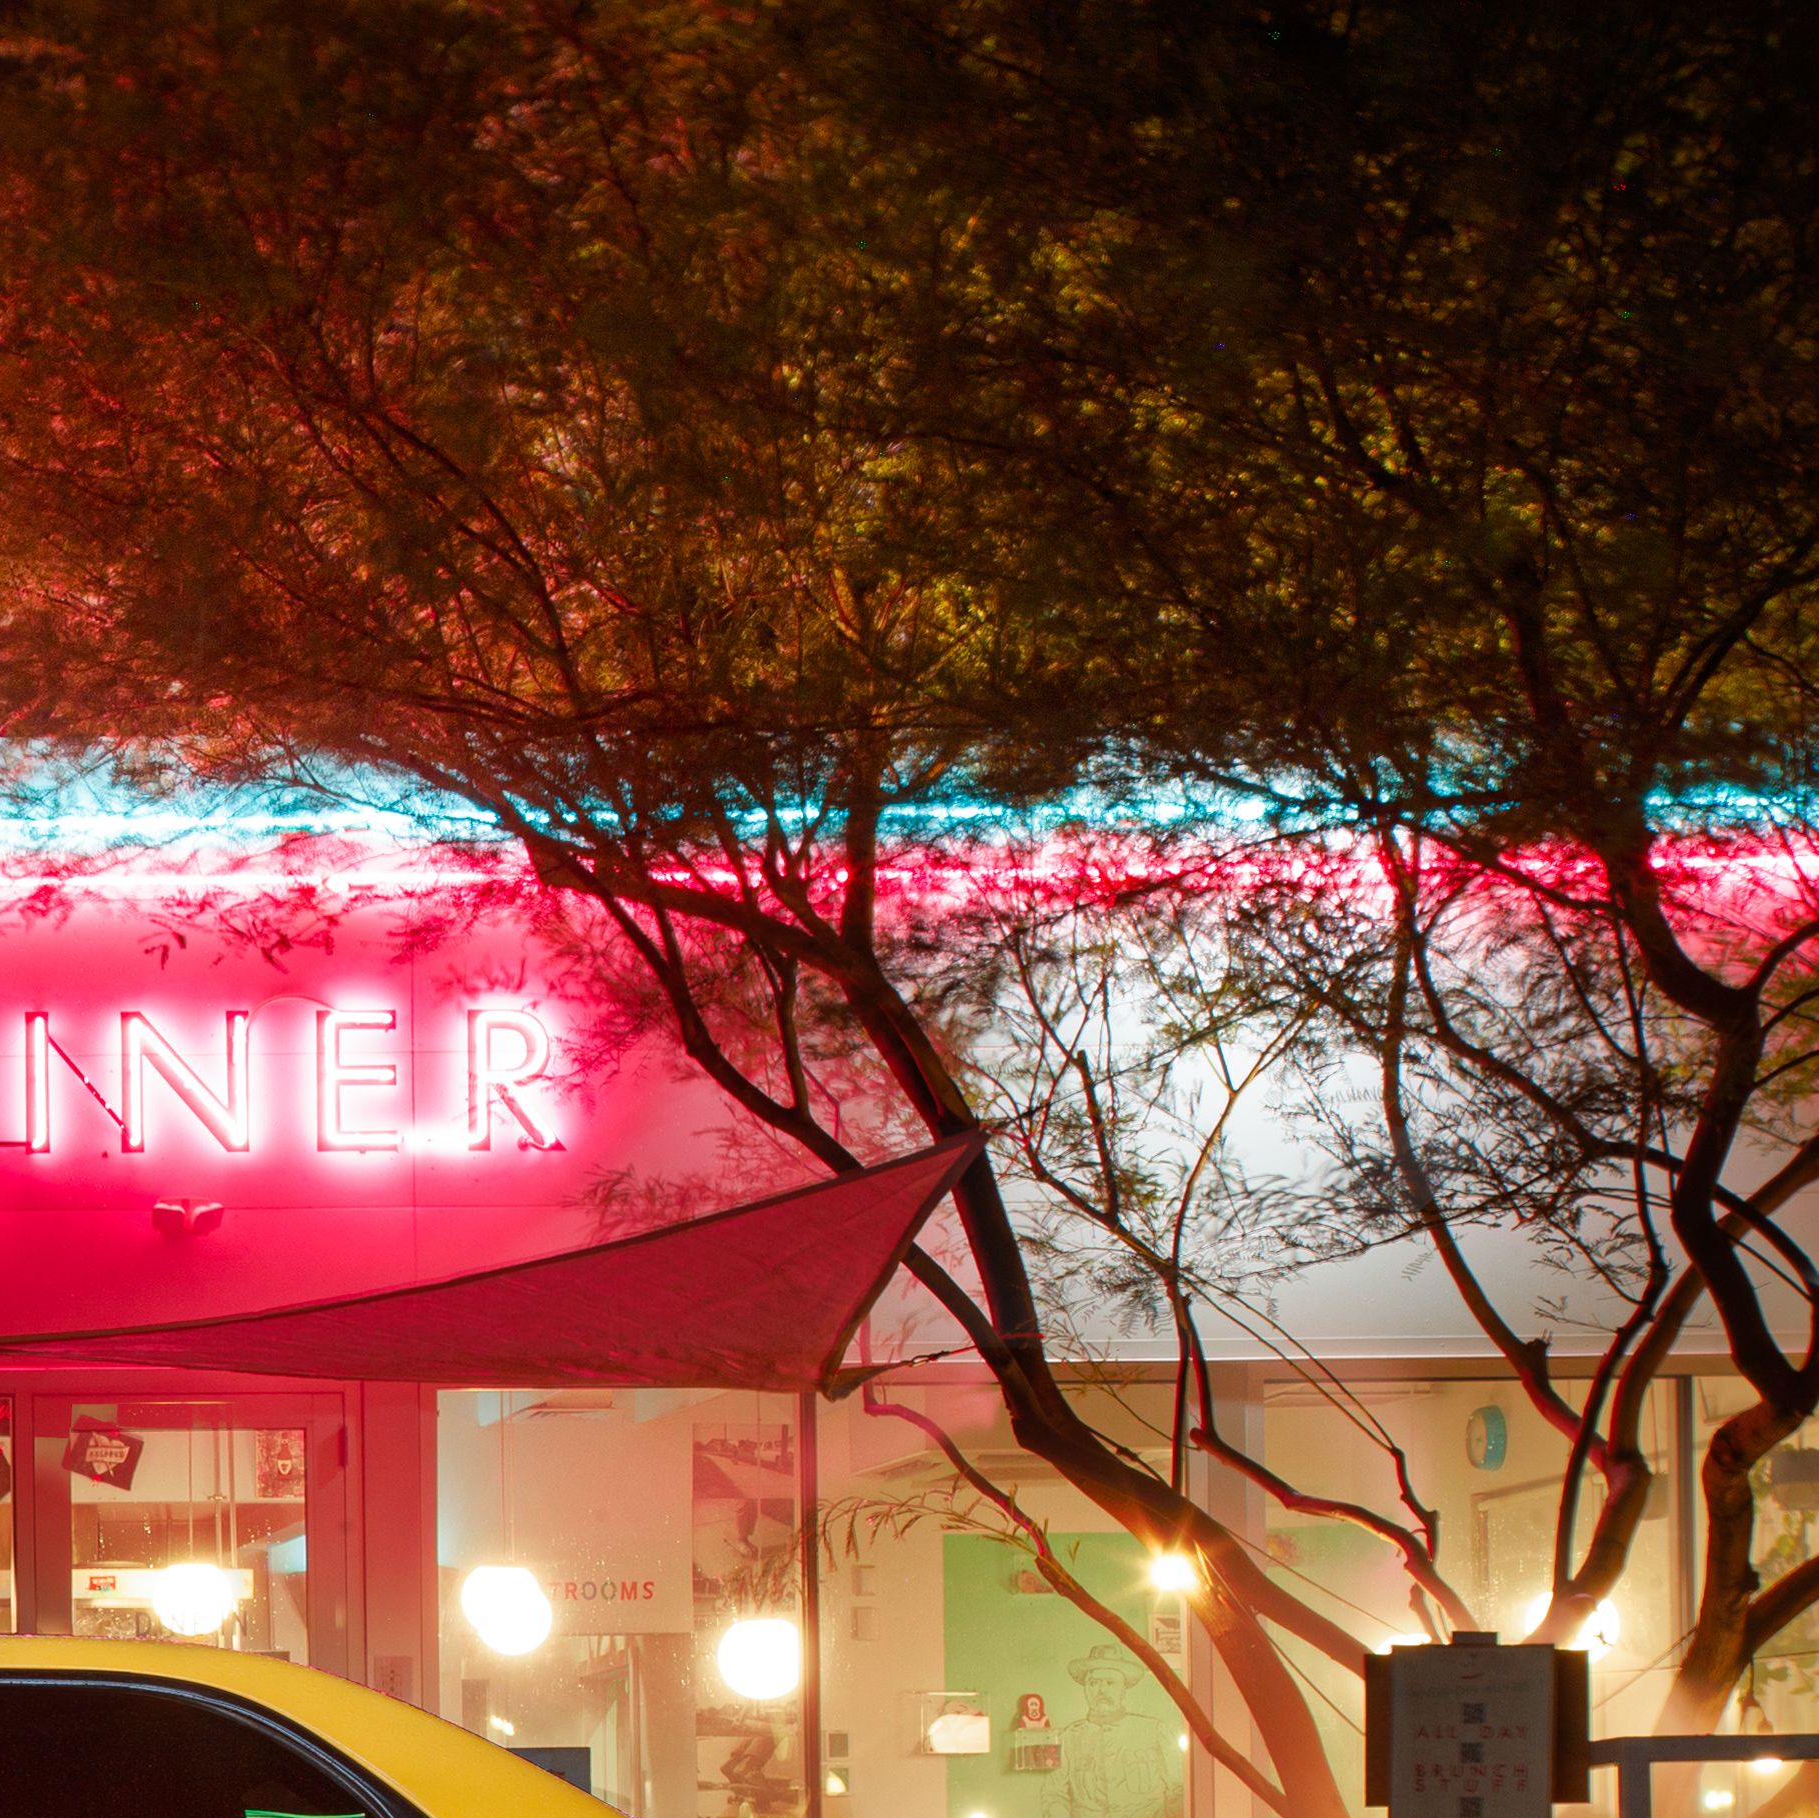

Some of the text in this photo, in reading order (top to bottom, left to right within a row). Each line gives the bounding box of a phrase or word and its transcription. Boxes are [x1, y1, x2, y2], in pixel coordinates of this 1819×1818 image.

[1417, 1724, 1527, 1739] ALL DAY
[1414, 1763, 1529, 1778] BRUNCH
[1414, 1778, 1529, 1793] STUFF
